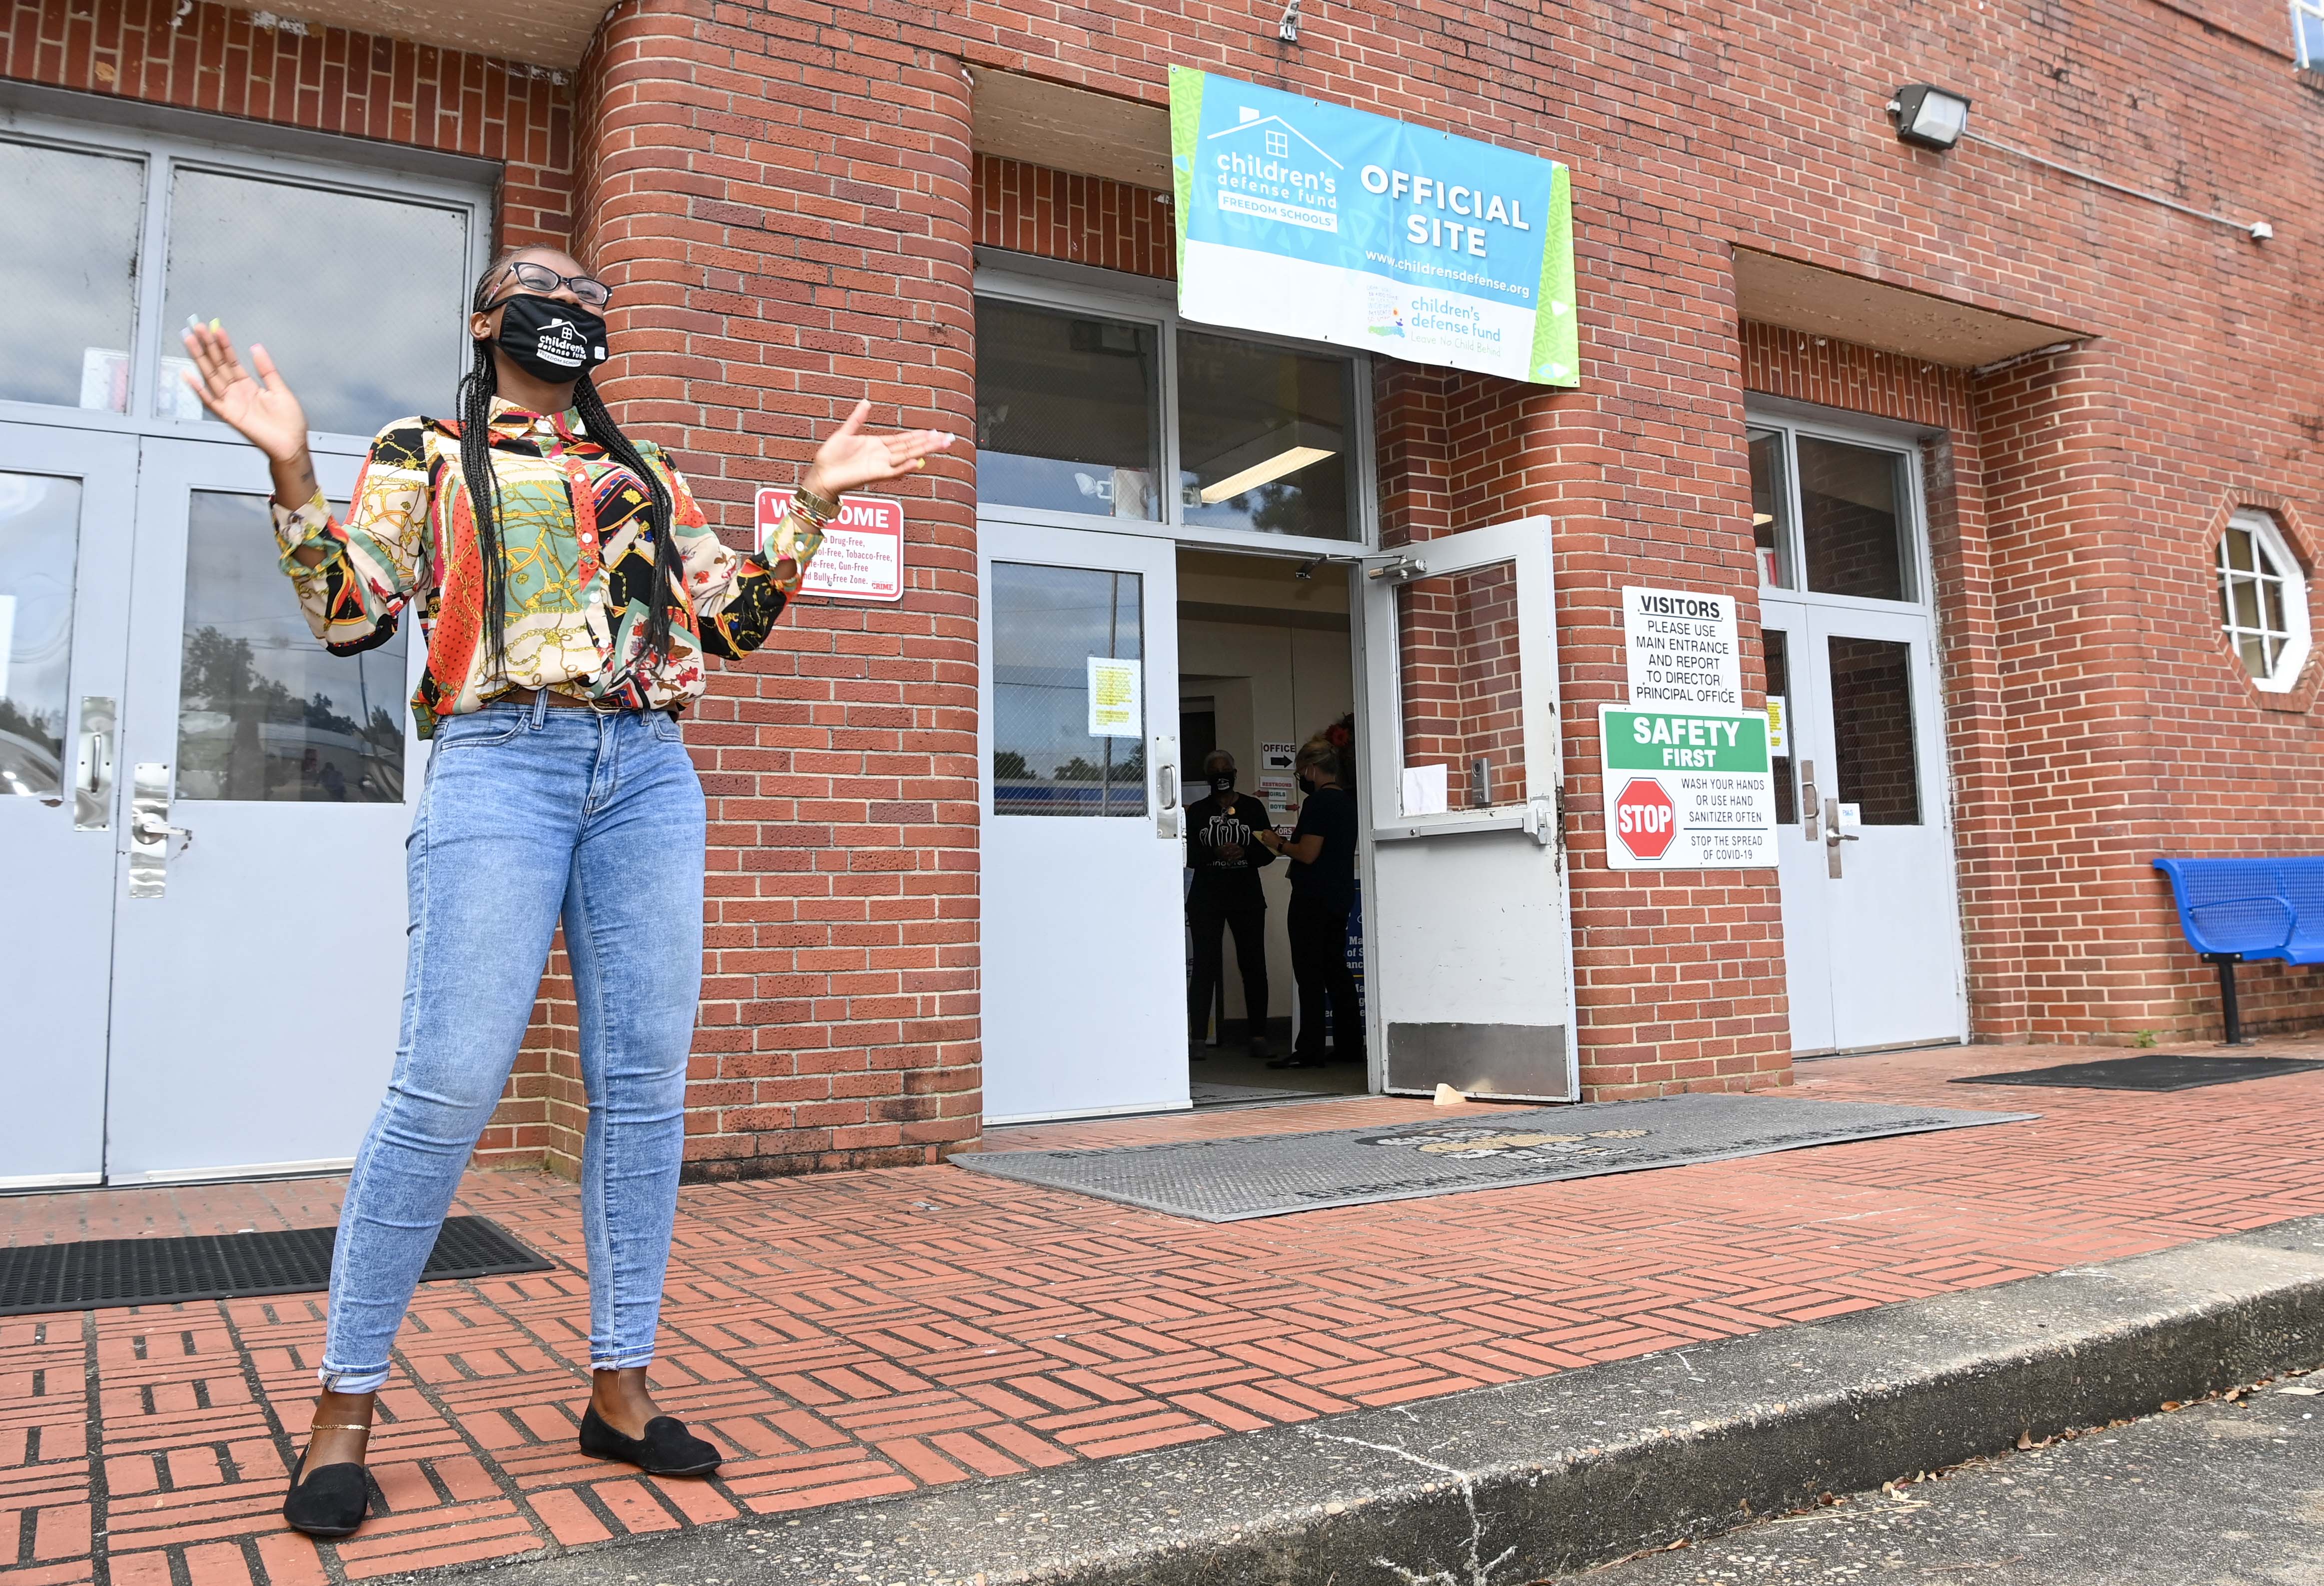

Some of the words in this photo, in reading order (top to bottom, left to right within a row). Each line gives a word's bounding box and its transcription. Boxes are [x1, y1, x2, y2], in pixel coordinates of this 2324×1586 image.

[1217, 152, 1336, 194] children's
[1217, 172, 1290, 199] defense
[1298, 188, 1337, 209] fund
[1360, 164, 1531, 231] OFFICIAL
[1223, 196, 1277, 215] FREEDOM
[1406, 214, 1488, 258] SITE
[1365, 250, 1530, 299] www.childrensdefense.org
[1411, 296, 1480, 321] children's
[1411, 313, 1468, 334] defense
[1472, 323, 1500, 342] fund
[537, 342, 570, 356] defense
[572, 352, 587, 360] fund
[539, 335, 585, 354] children's
[1411, 331, 1436, 344] Leave
[1440, 336, 1452, 346] No
[1455, 338, 1474, 351] Child
[1477, 342, 1501, 357] Behind
[539, 351, 562, 362] FREEDOM
[771, 498, 889, 528] WOME
[830, 536, 865, 548] Drug-Free,
[846, 549, 892, 563] Tobacco-Free,
[810, 560, 836, 570] fe-Free,
[839, 562, 869, 572] Gun-Free
[803, 572, 811, 580] nd
[814, 572, 847, 583] Bully-Free
[850, 575, 868, 584] Zone.
[871, 582, 893, 590] CRIME
[1640, 595, 1720, 618] VISITORS
[1648, 620, 1691, 635] PLEASE
[1694, 624, 1716, 637] USE
[1636, 636, 1665, 650] MAIN
[1669, 639, 1729, 654] ENTRANCE
[1649, 654, 1672, 667] AND
[1677, 656, 1720, 670] REPORT
[1646, 670, 1662, 683] TO
[1666, 672, 1724, 688] DIRECTOR/
[1636, 686, 1693, 702] PRINCIPAL
[1697, 690, 1736, 703] OFFICE
[1633, 716, 1740, 747] SAFETY
[1263, 744, 1296, 752] OFFICE
[1663, 748, 1716, 768] FIRST
[1681, 778, 1707, 790] WASH
[1710, 778, 1734, 790] YOUR
[1736, 779, 1764, 790] HANDS
[1696, 795, 1708, 806] OR
[1711, 795, 1727, 806] USE
[1730, 795, 1753, 806] HAND
[1619, 804, 1672, 833] STOP
[1689, 811, 1733, 822] SANITIZER
[1735, 812, 1762, 822] OFTEN
[1691, 836, 1711, 846] STOP
[1715, 836, 1729, 846] THE
[1732, 836, 1763, 846] SPREAD
[1704, 850, 1713, 860] OF
[1716, 850, 1753, 860] COVID-19
[1347, 948, 1356, 957] of
[1048, 1142, 1229, 1158] BULLOCK
[1231, 1129, 1365, 1144] COUNTY
[1368, 1110, 1570, 1131] VOCATIONAL
